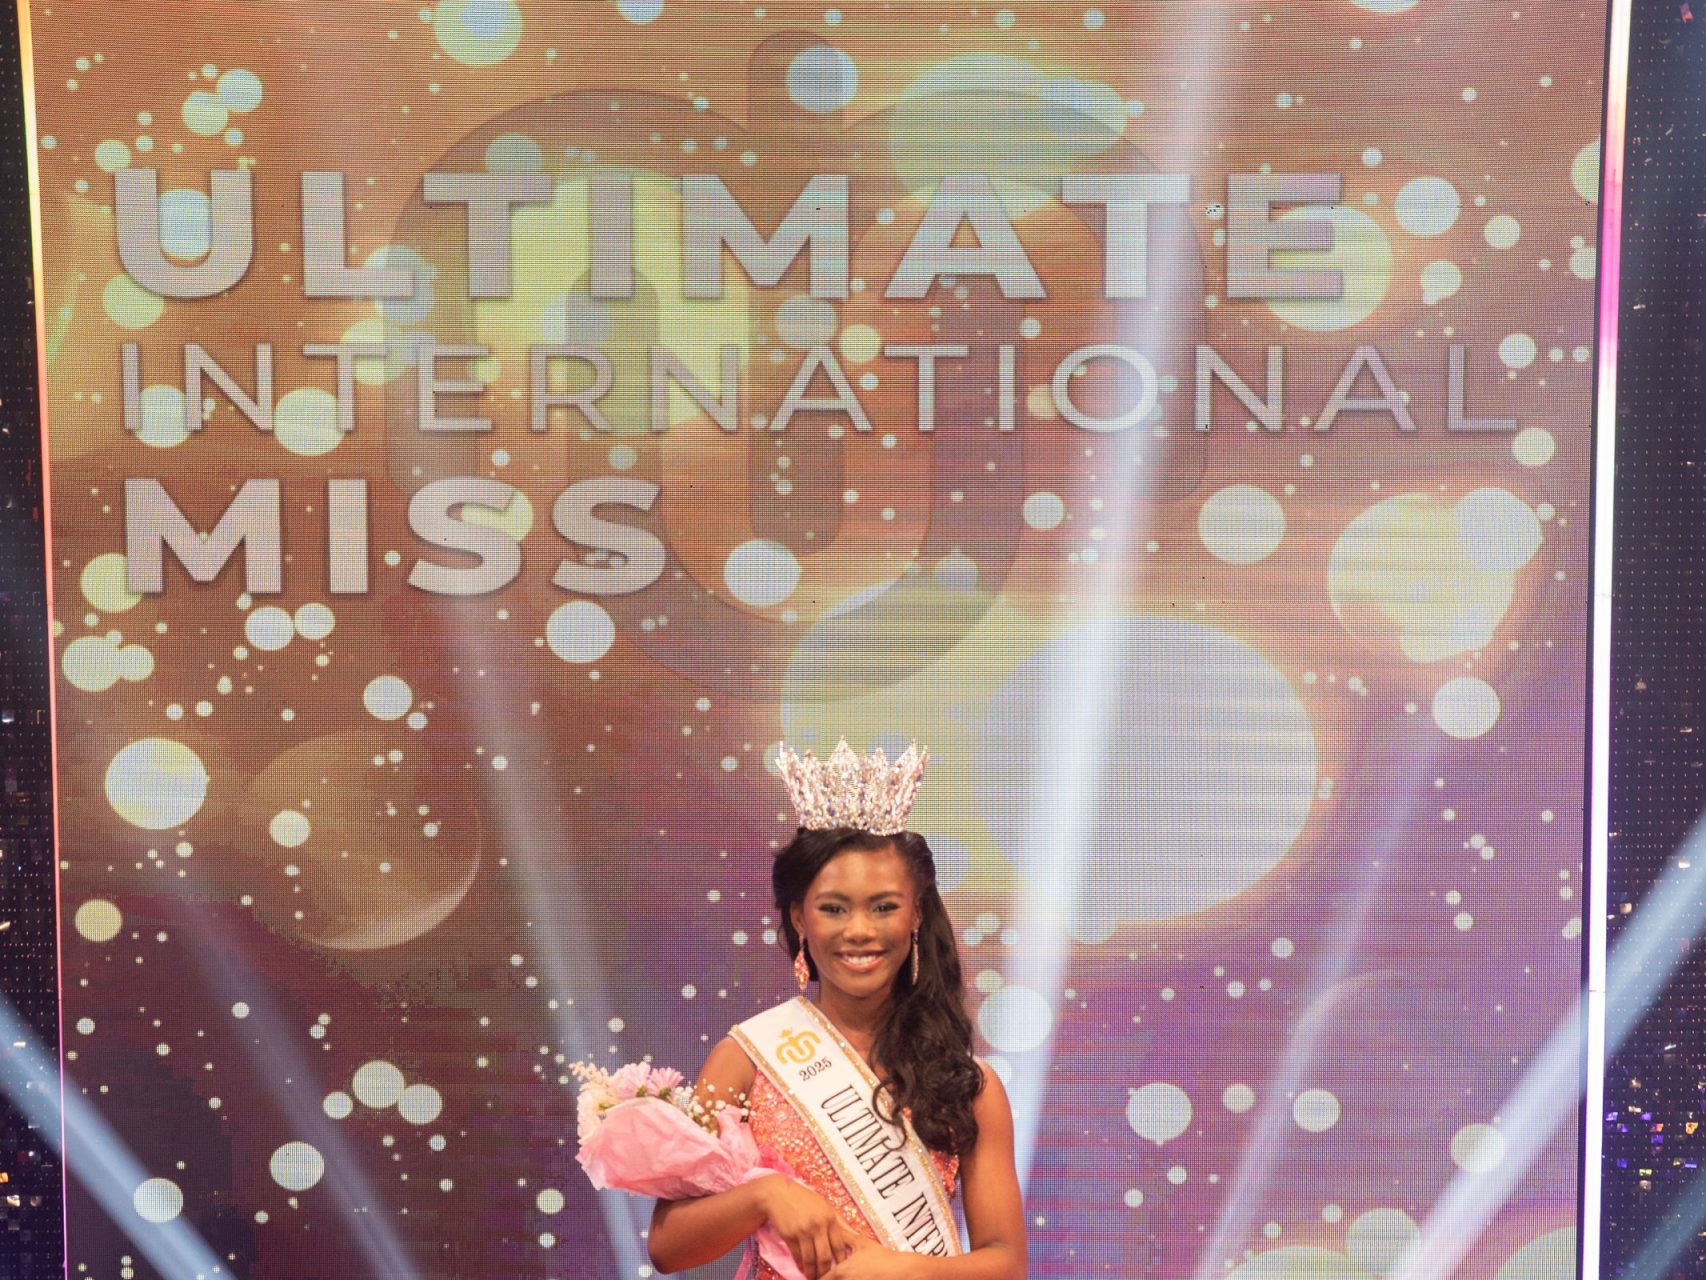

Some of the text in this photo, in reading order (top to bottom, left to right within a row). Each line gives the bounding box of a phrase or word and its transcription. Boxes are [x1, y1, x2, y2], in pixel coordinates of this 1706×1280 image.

[113, 168, 1344, 299] ULTIMATE
[121, 342, 1518, 432] INTERNATIONAL
[123, 475, 668, 596] MISS
[799, 1057, 833, 1082] 2025
[820, 1084, 916, 1200] ULTIMATE
